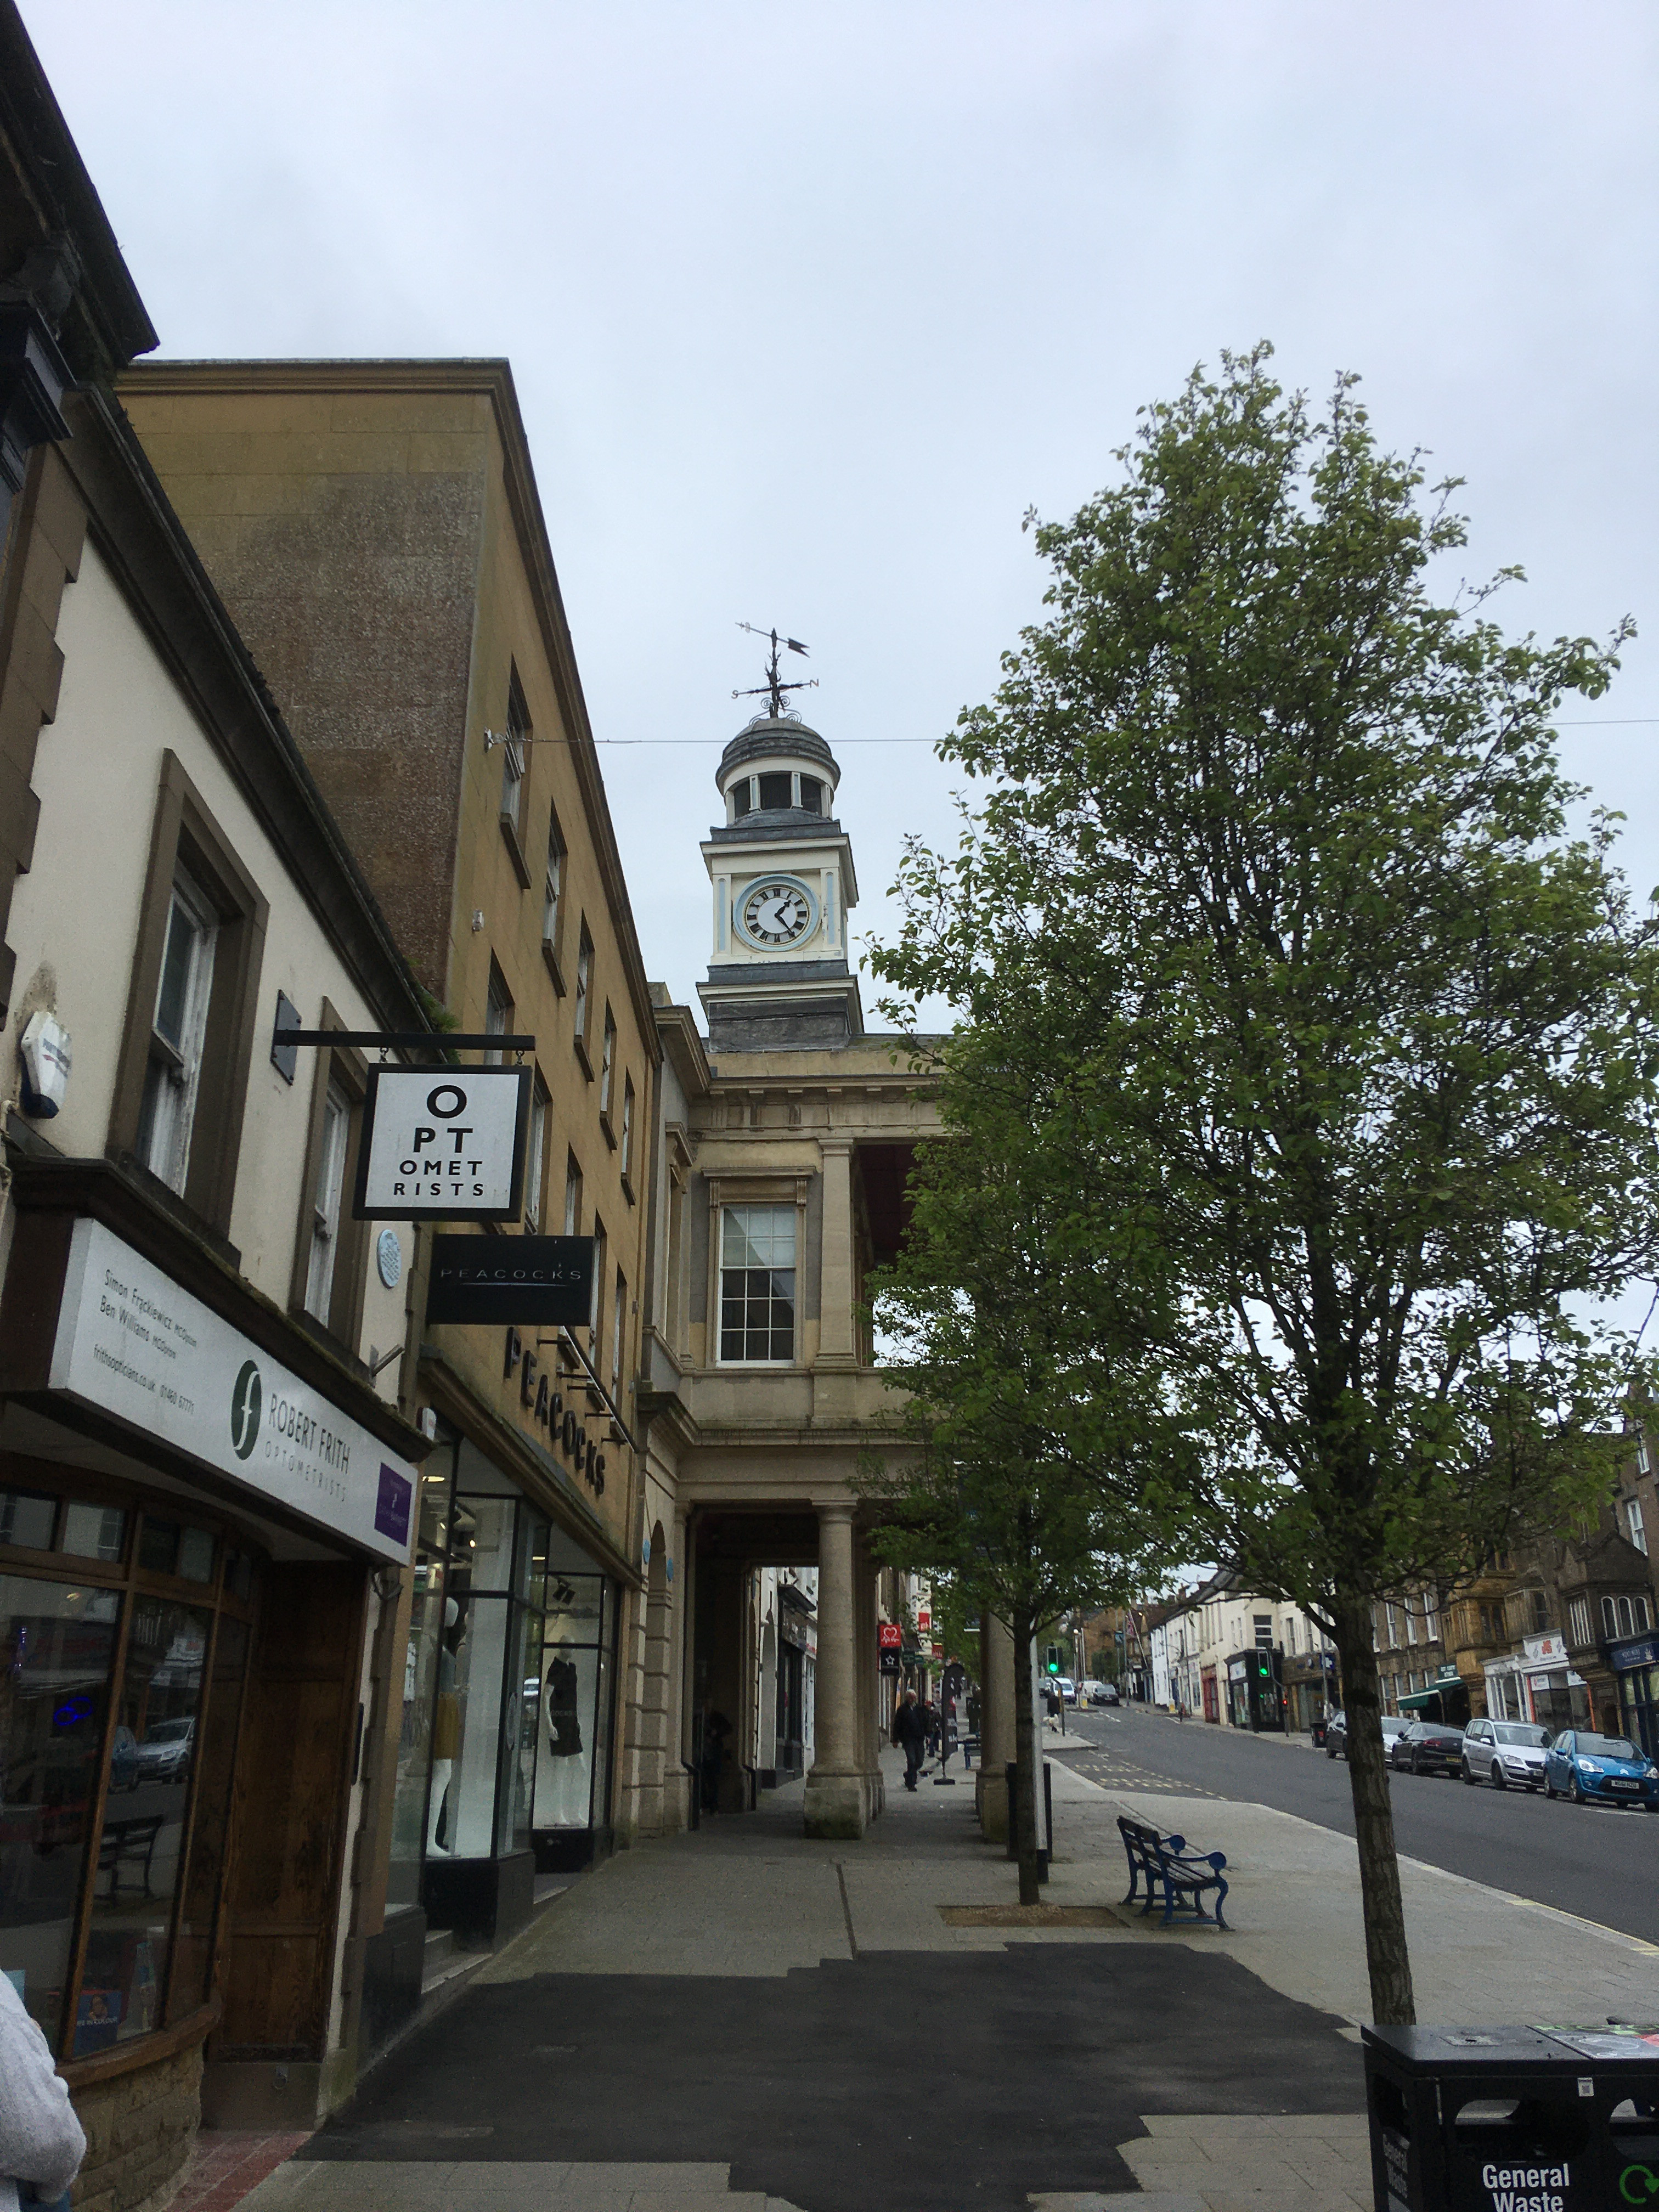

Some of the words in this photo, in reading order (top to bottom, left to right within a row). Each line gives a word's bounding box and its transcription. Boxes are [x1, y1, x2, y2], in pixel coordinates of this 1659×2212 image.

[427, 1085, 467, 1119] O
[399, 1160, 483, 1176] OMET
[393, 1183, 483, 1197] RISTS
[104, 1269, 128, 1299] Simon
[441, 1269, 582, 1280] PEACOCKS
[100, 1295, 116, 1318] Ben
[119, 1306, 150, 1342] Williams
[504, 1327, 605, 1497] PEACOCKS
[269, 1392, 317, 1451] ROBERT
[319, 1429, 351, 1475] FRITH
[265, 1440, 346, 1502] OPTOMETRISTS
[1482, 2163, 1570, 2189] General
[1492, 2192, 1564, 2212] Waste
